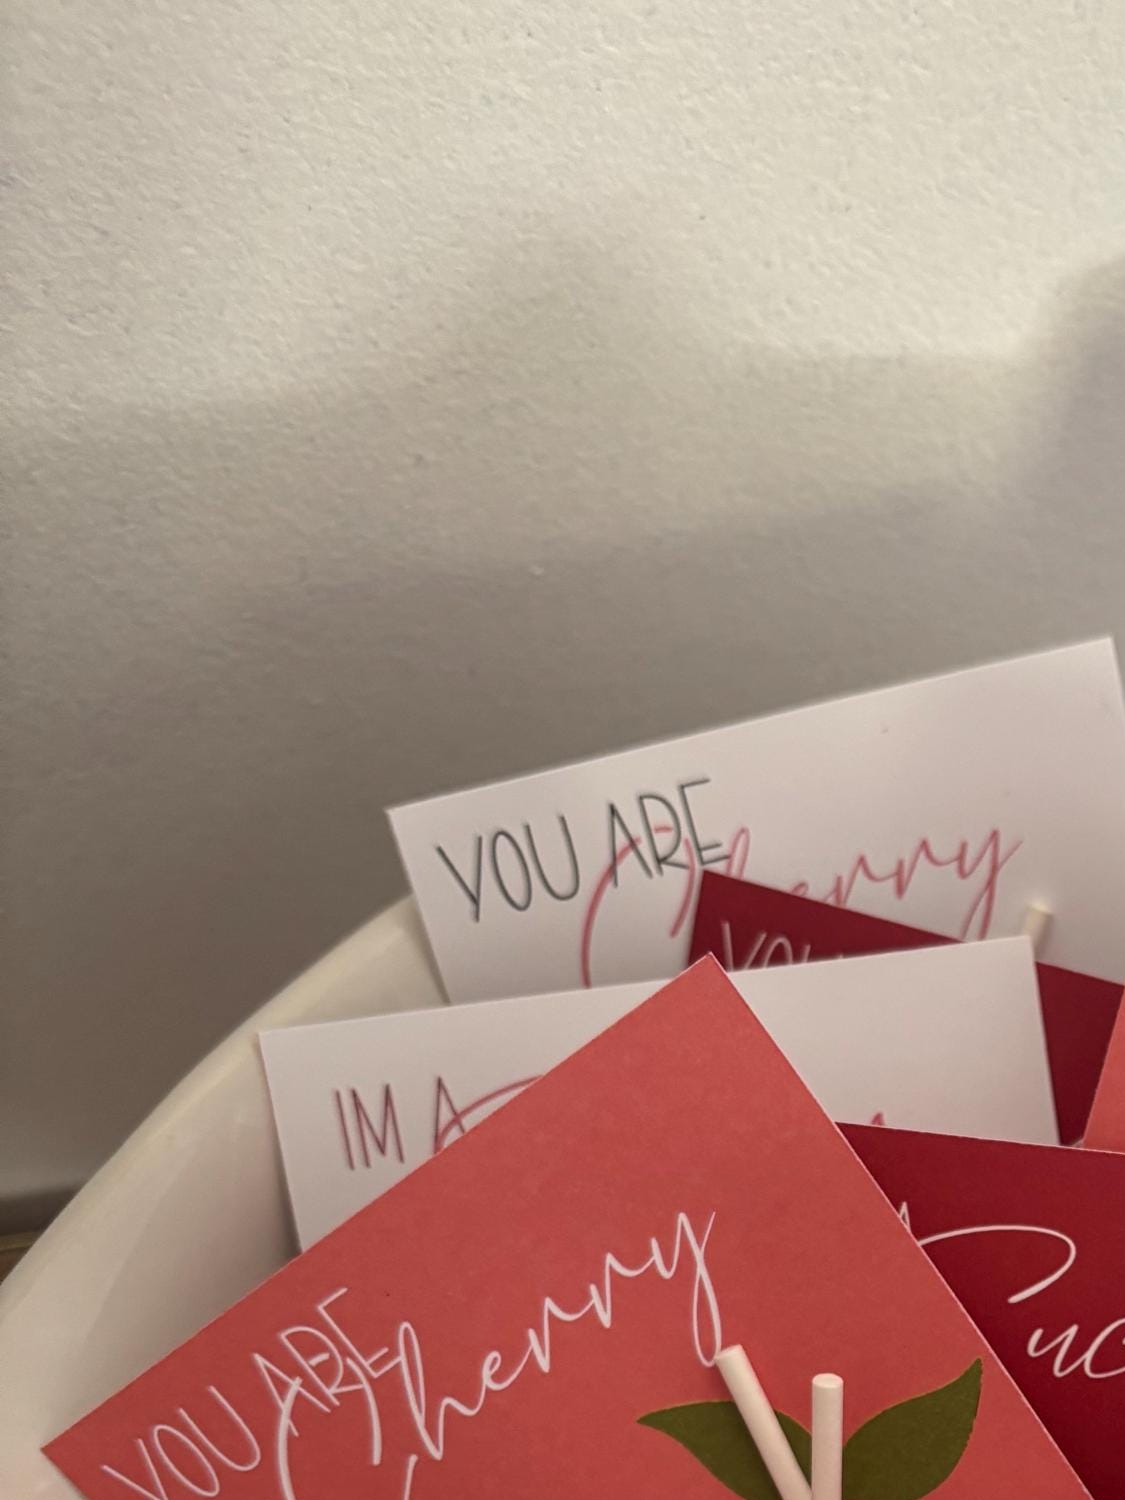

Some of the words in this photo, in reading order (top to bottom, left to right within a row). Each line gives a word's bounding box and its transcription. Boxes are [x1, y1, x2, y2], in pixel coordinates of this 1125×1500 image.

[435, 813, 582, 924] YOU
[604, 776, 731, 890] ARE
[334, 1082, 406, 1172] IM
[432, 1074, 467, 1155] A
[252, 1286, 402, 1437] ARE
